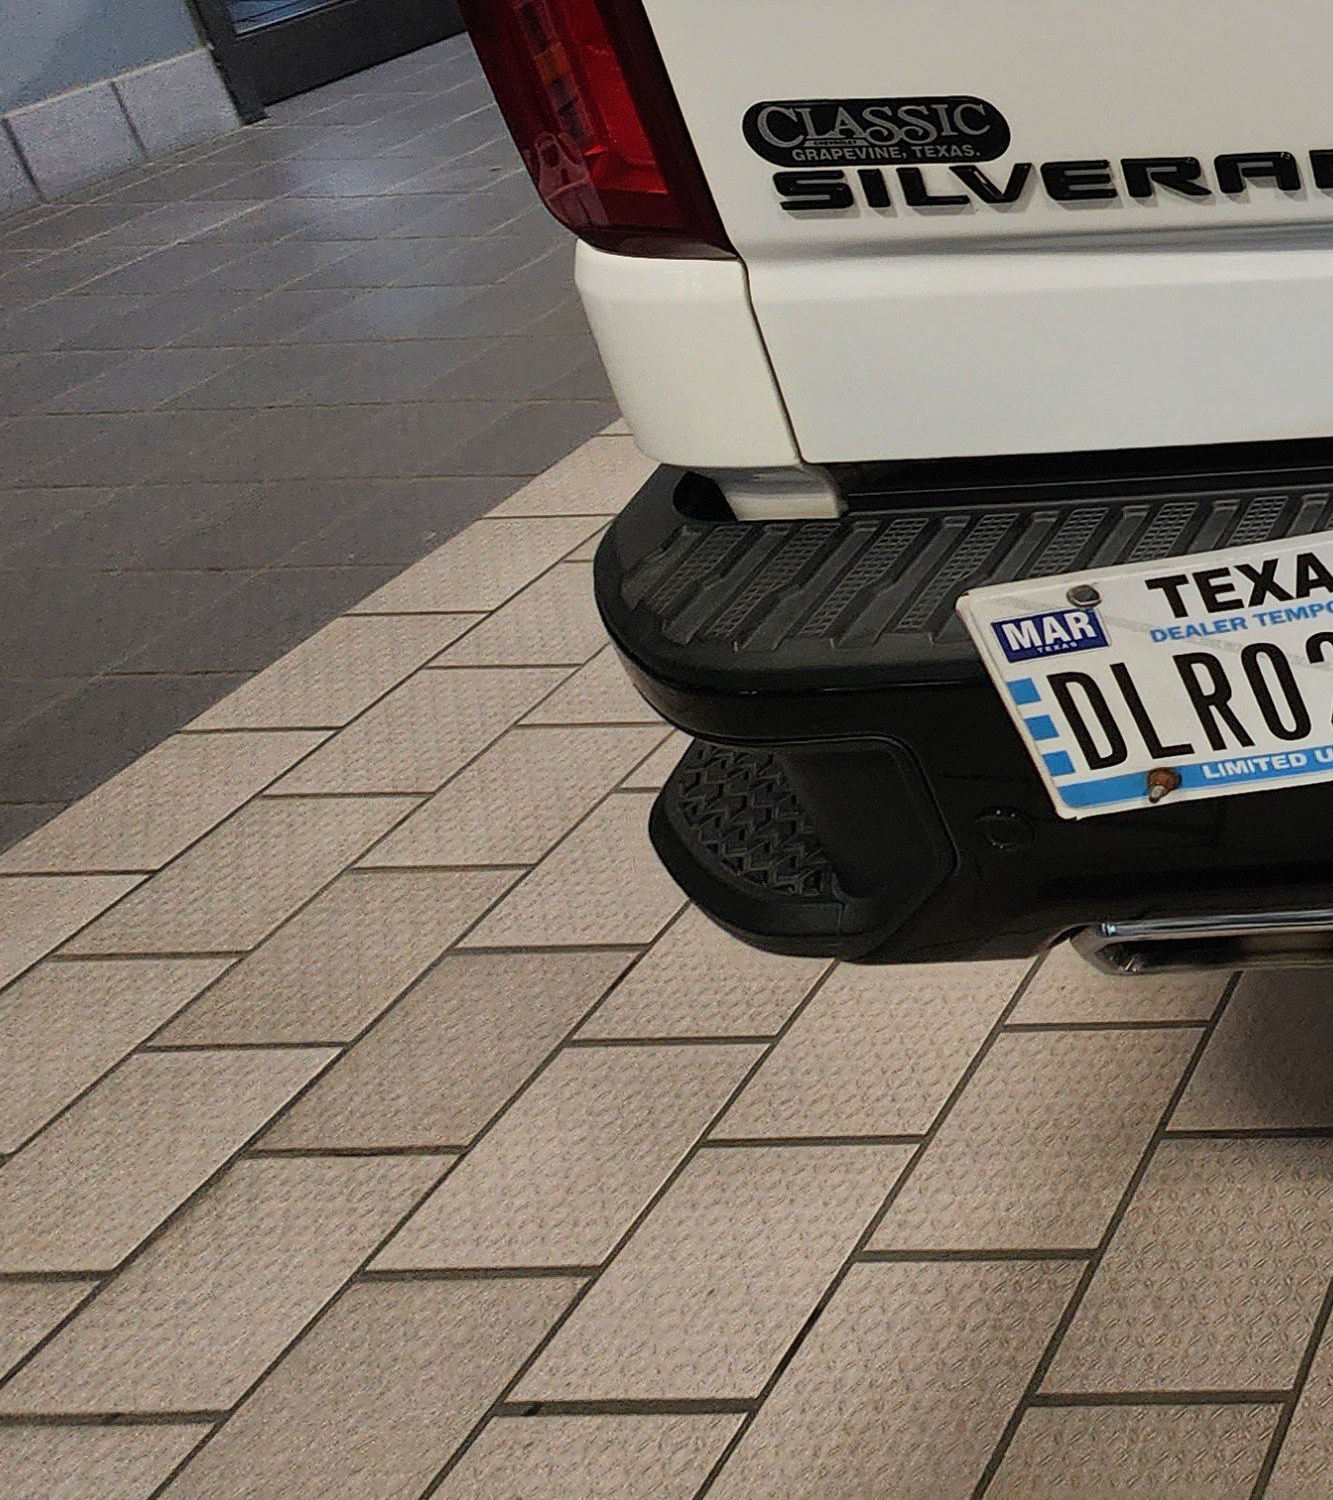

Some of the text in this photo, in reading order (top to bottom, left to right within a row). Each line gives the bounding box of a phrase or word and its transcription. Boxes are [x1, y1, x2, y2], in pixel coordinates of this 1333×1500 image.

[757, 103, 991, 148] CLASSIC
[792, 144, 981, 162] GRAPEVINE, TEXAS.
[1002, 611, 1098, 652] MAR
[1150, 615, 1248, 643] DEALER
[1036, 641, 1078, 653] TEXAS
[1202, 752, 1307, 780] LIMITED
